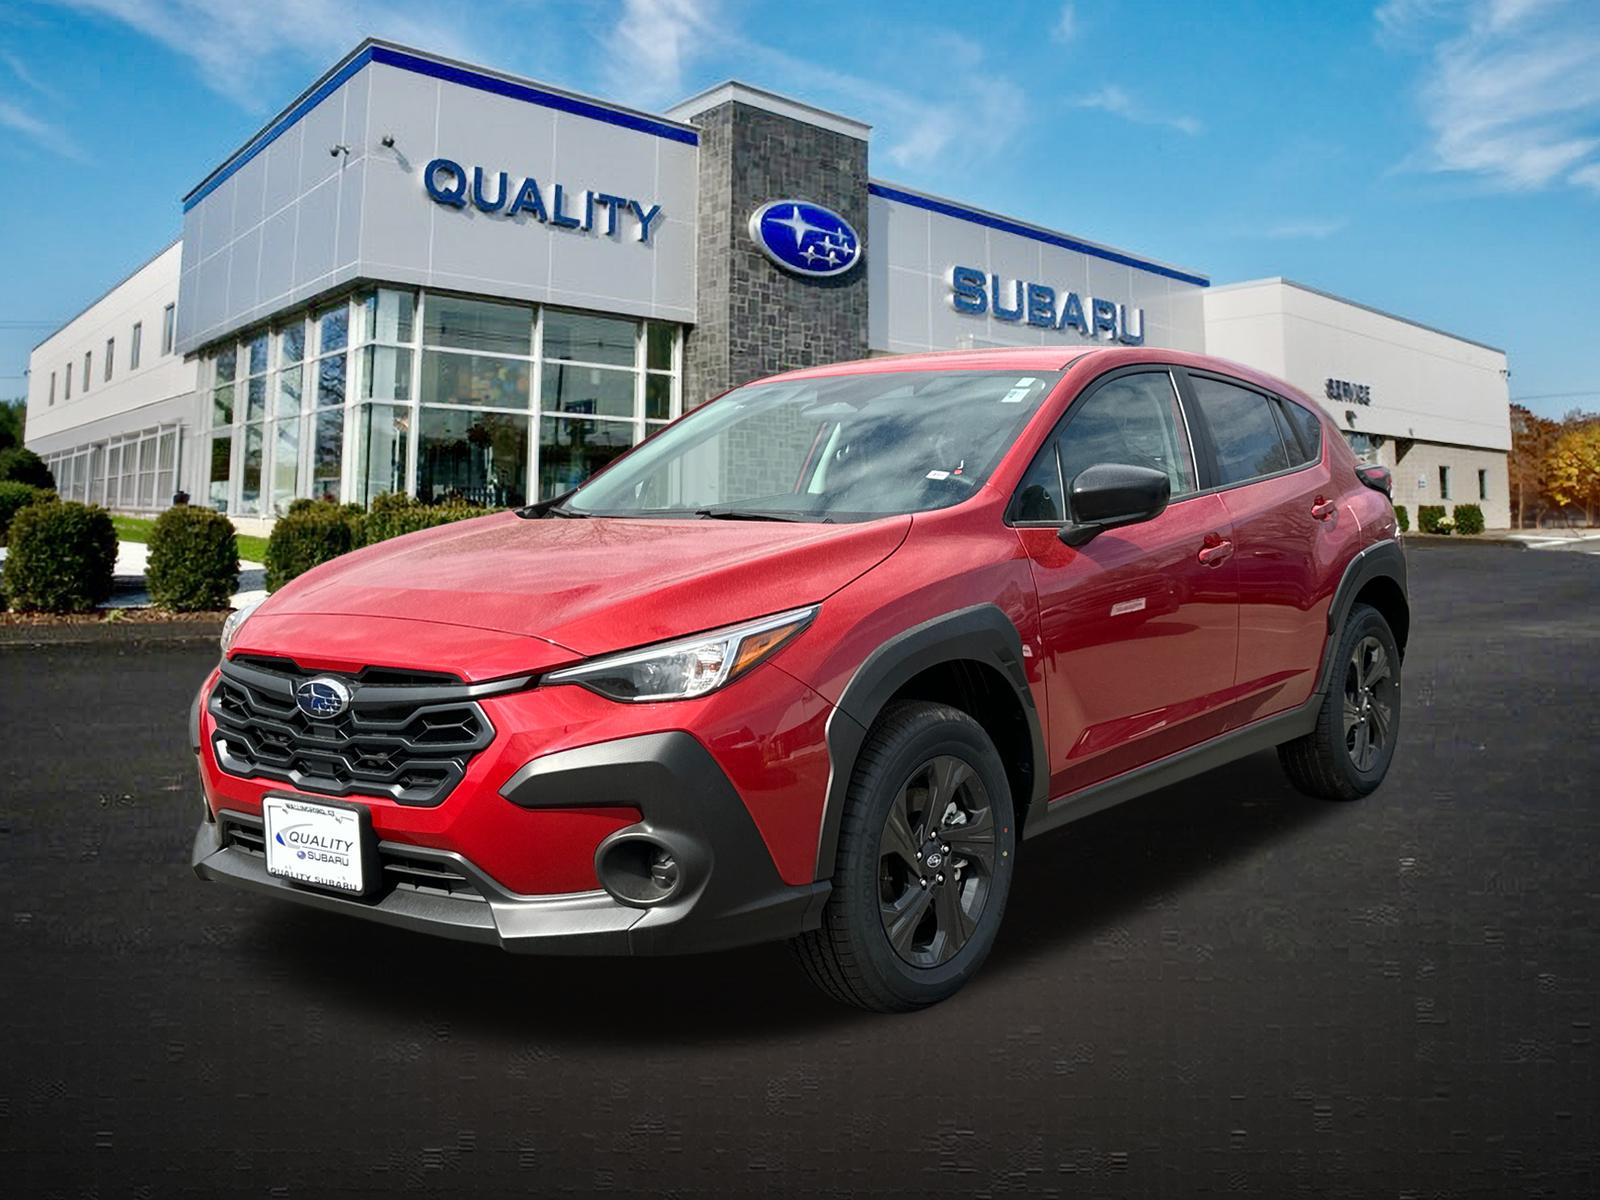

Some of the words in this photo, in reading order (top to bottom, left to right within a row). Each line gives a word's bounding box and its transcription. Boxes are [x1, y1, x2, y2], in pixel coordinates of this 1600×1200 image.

[424, 158, 662, 242] QUALITY
[951, 265, 1145, 346] SUBARU
[1325, 378, 1370, 406] SERVICE
[289, 831, 353, 852] QUALITY
[307, 851, 349, 866] SUBARU
[270, 867, 311, 881] QUALITY
[315, 876, 357, 891] SUBARU
